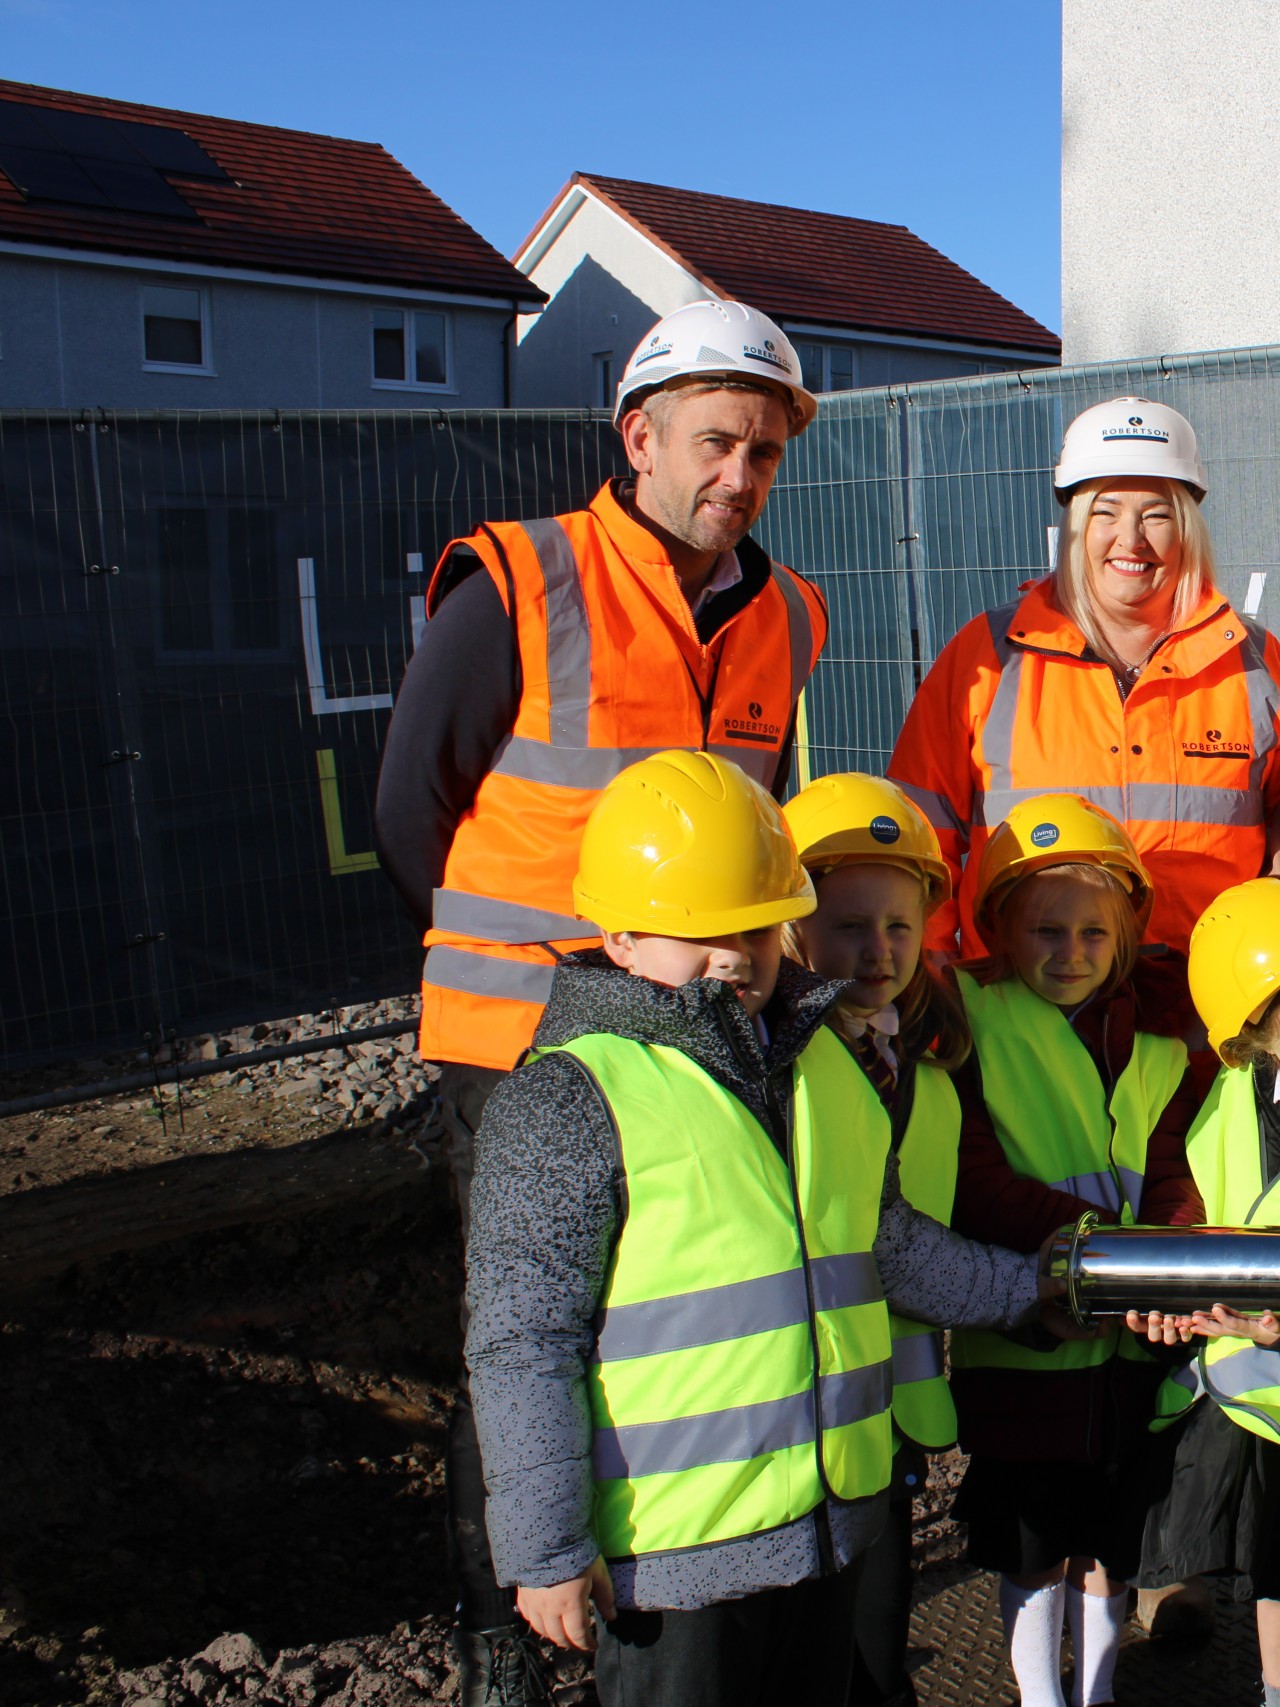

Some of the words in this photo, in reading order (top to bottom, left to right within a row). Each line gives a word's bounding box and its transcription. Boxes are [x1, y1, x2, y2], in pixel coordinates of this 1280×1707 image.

[743, 345, 792, 369] ROBERTSON
[1102, 428, 1169, 437] ROBERTSON
[724, 719, 780, 735] ROBERTSON
[1182, 742, 1250, 751] ROBERTSON
[1033, 829, 1053, 837] Living
